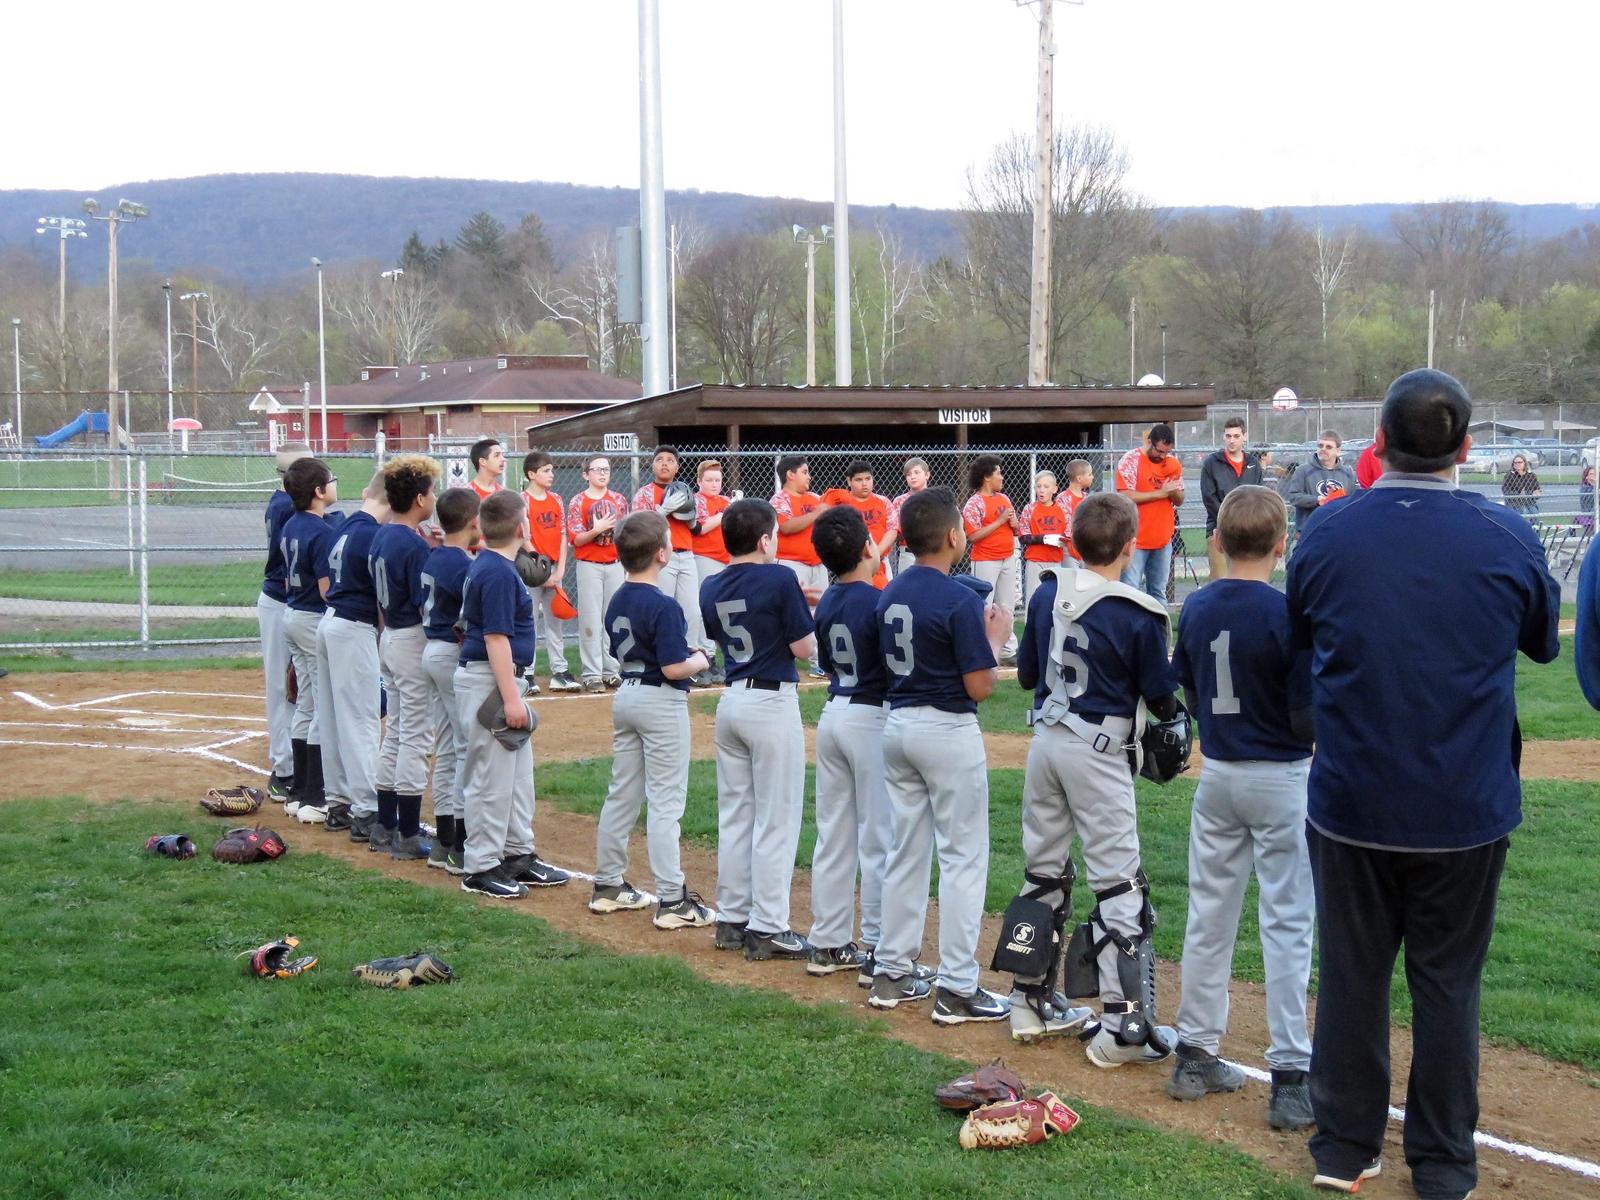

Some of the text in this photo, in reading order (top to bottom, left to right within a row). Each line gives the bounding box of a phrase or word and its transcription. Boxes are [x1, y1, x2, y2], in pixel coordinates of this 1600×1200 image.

[605, 435, 631, 449] VISITO
[941, 408, 988, 422] VISITOR
[280, 536, 302, 587] 12
[328, 534, 349, 583] 4
[421, 571, 435, 627] 7
[612, 616, 645, 673] 2
[715, 599, 754, 663] 5
[829, 623, 858, 687] 9
[884, 603, 915, 676] 3
[1209, 630, 1241, 715] 1
